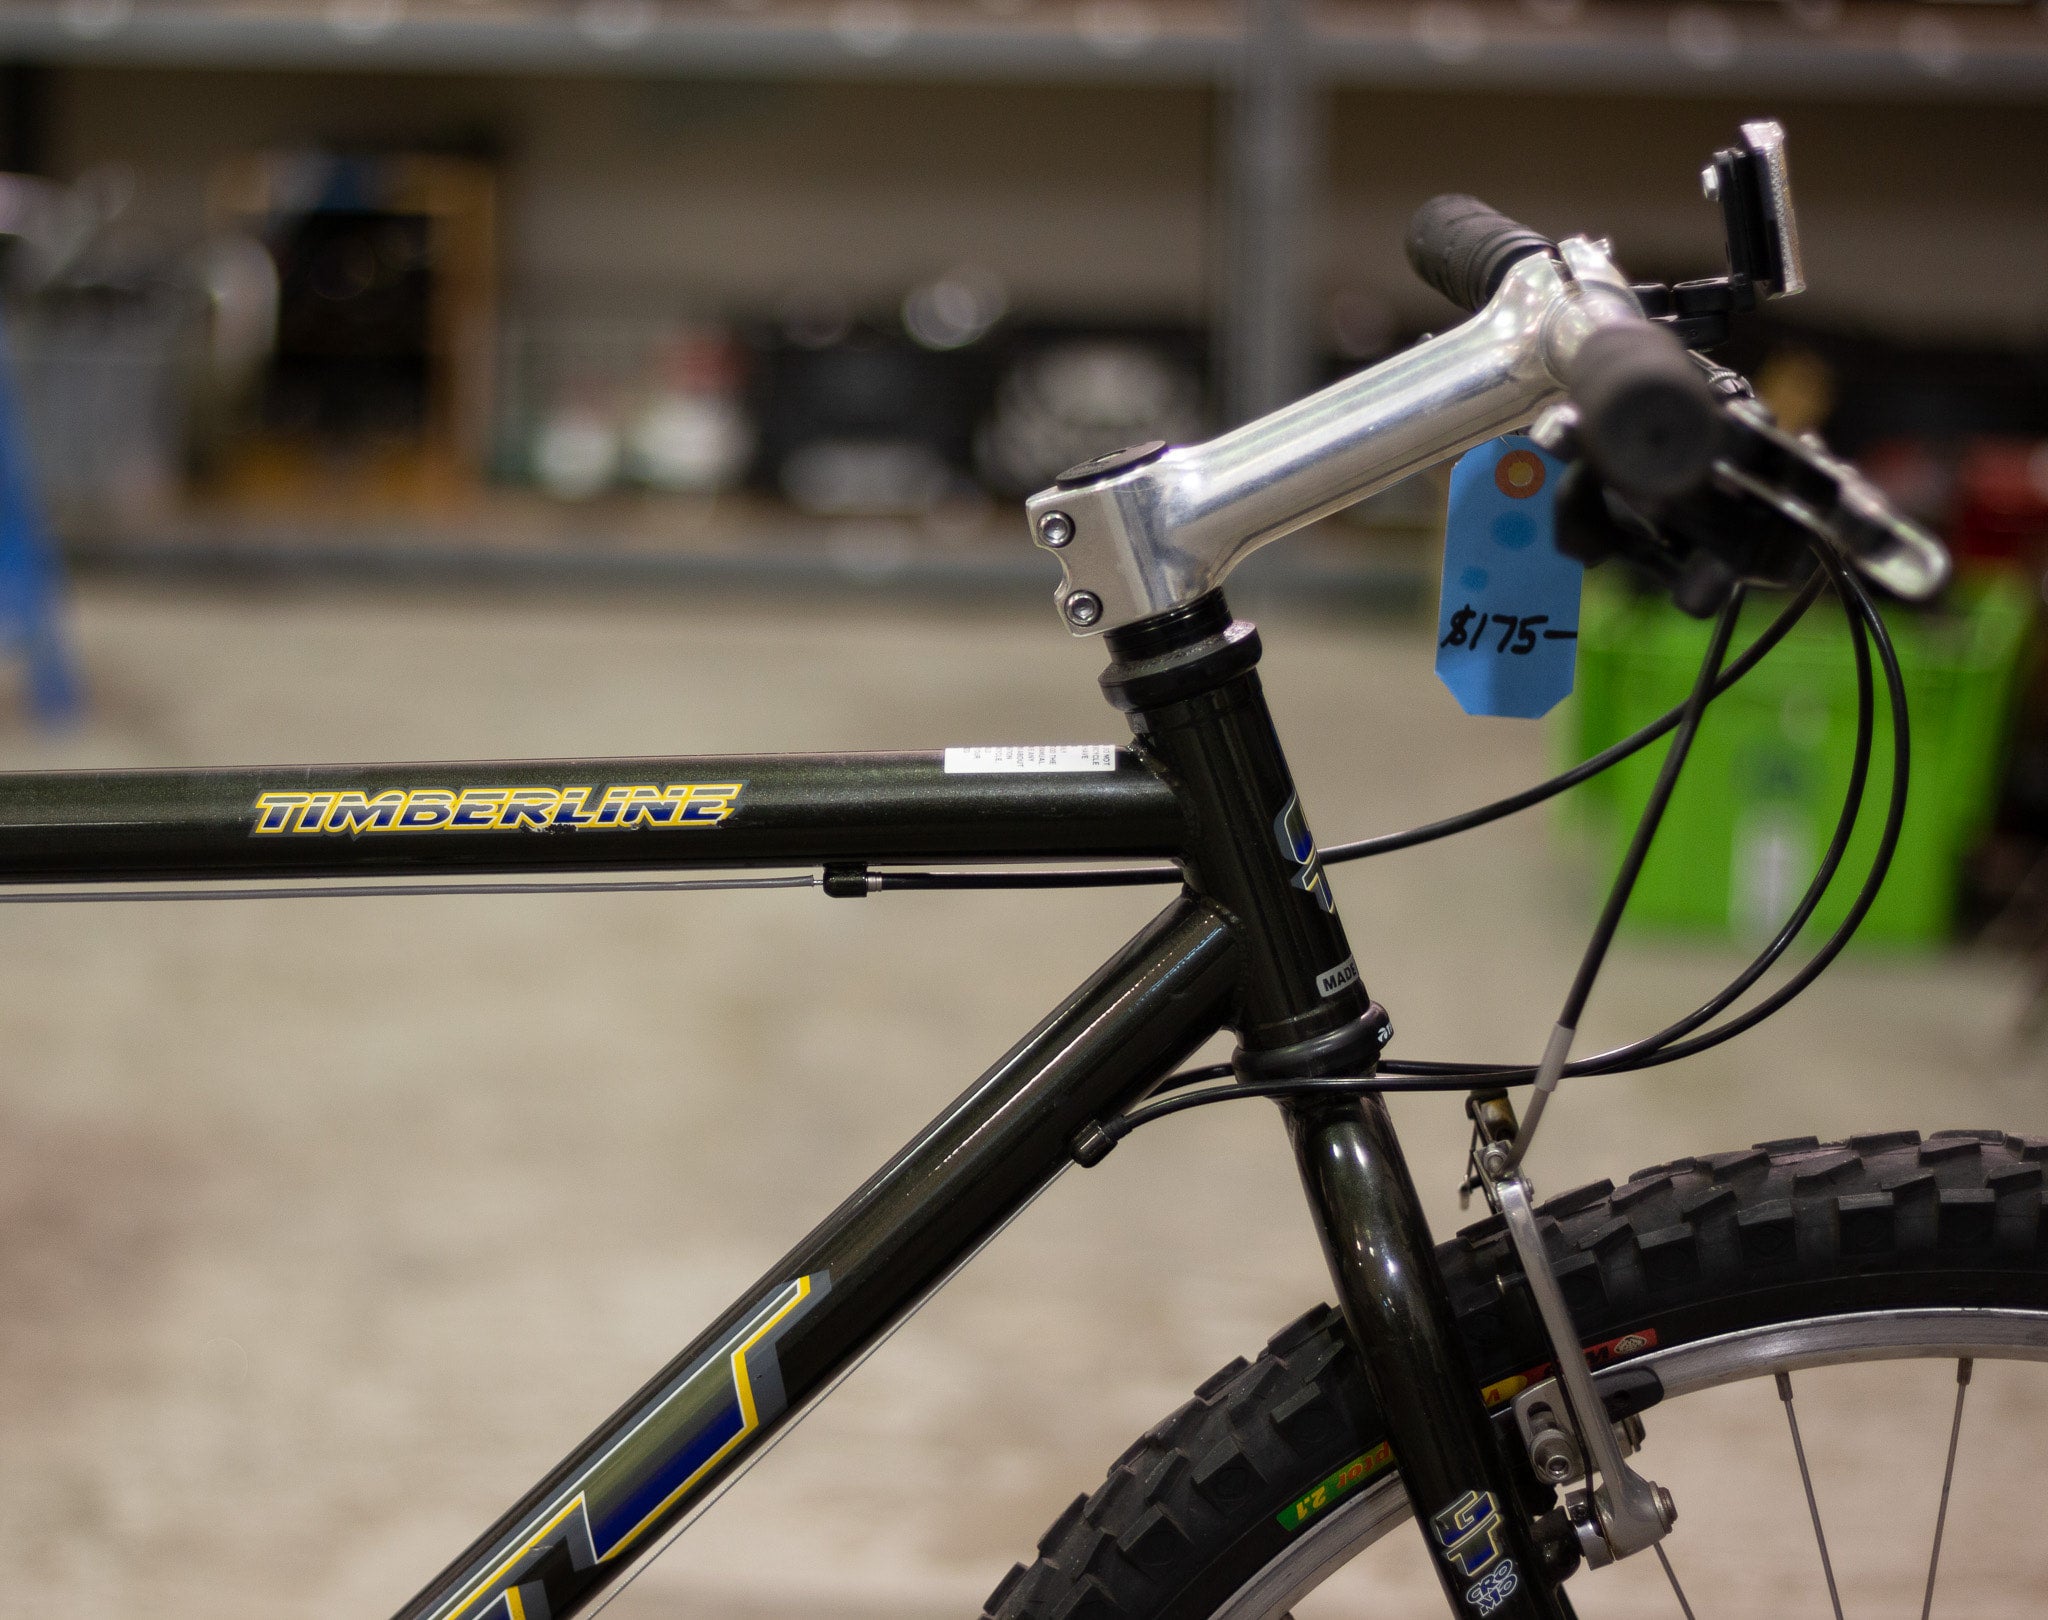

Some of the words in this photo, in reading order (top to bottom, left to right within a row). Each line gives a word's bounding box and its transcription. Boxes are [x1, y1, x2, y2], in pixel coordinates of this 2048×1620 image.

[253, 781, 745, 837] TIMBERLINE
[1322, 961, 1357, 992] MADE
[1296, 1485, 1326, 1521] 2.1
[1433, 1489, 1502, 1578] GT
